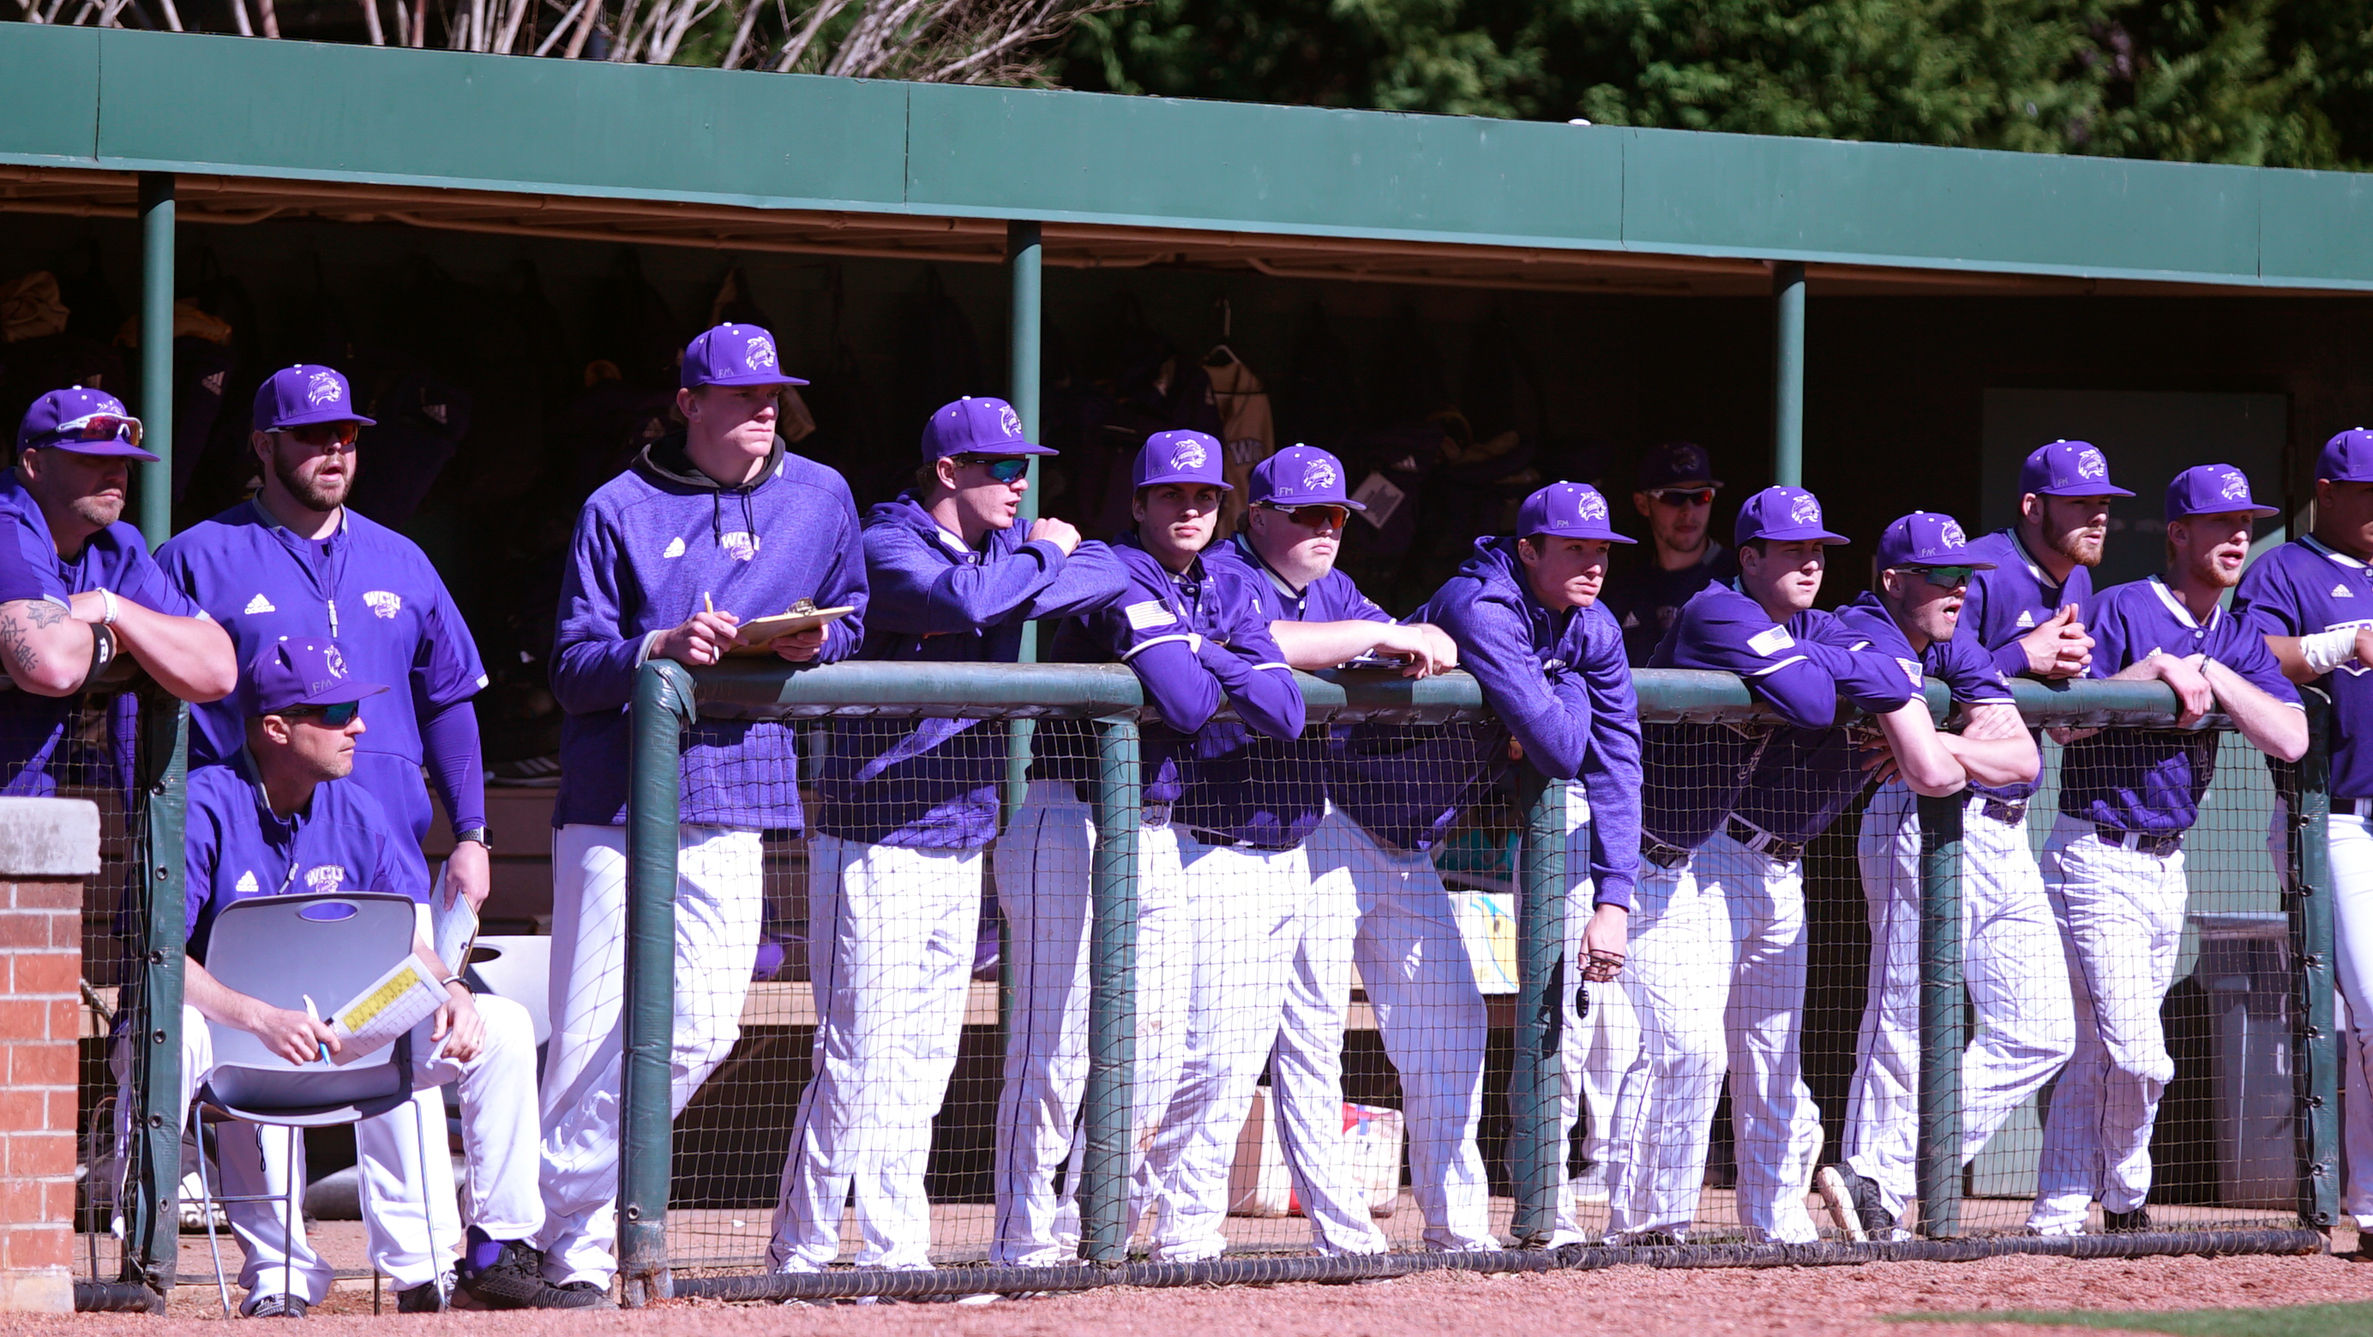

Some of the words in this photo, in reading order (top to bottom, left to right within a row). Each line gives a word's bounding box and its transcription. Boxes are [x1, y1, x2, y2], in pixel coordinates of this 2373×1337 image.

[1279, 486, 1293, 496] FM
[363, 590, 401, 610] WCU
[304, 864, 345, 888] WCU
